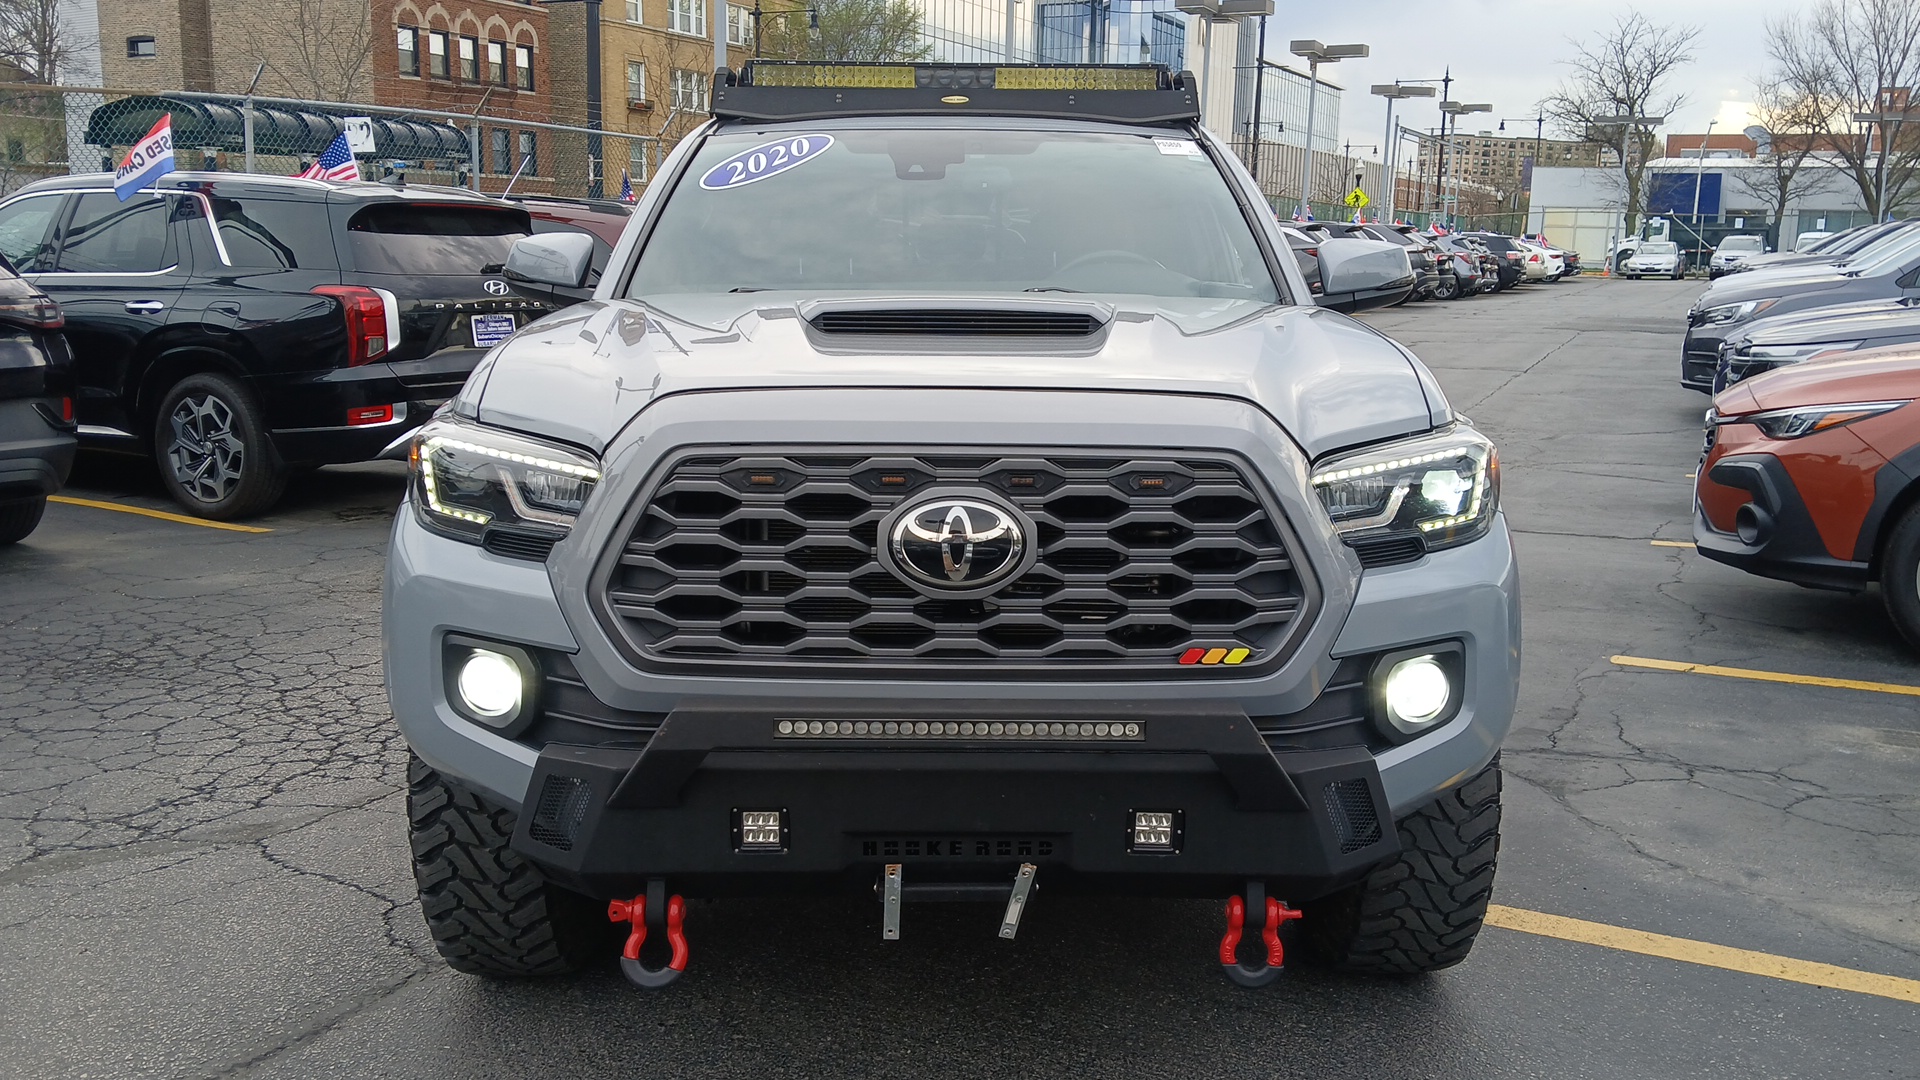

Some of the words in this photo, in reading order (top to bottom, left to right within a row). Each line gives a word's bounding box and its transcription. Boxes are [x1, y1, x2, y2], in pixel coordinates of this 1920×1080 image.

[726, 138, 810, 184] 2020
[863, 841, 962, 856] HOOKE
[976, 841, 1053, 856] ROAD
